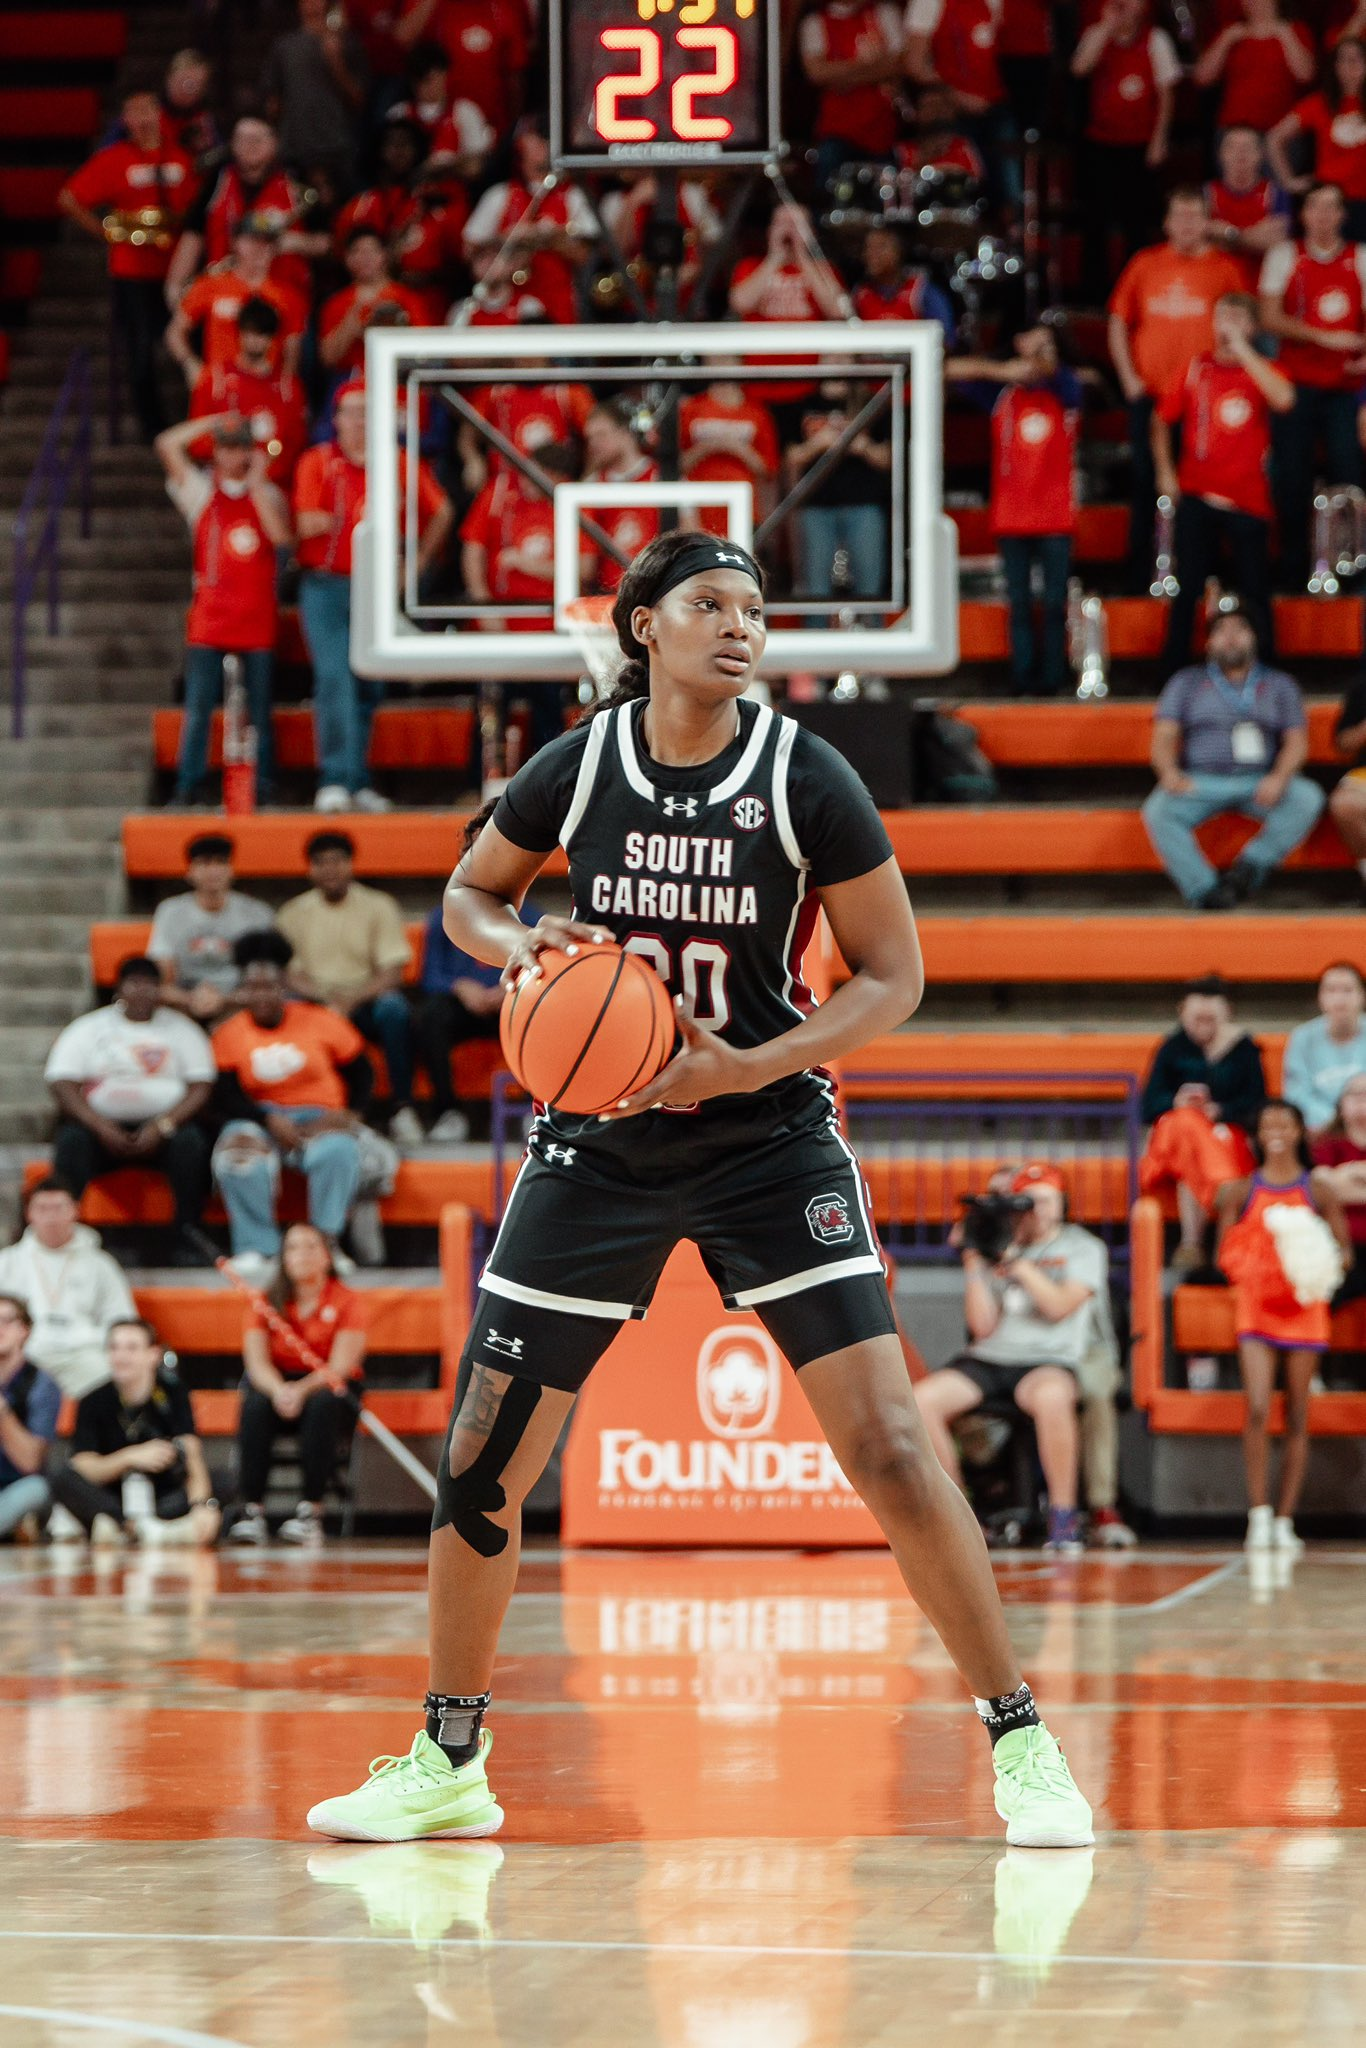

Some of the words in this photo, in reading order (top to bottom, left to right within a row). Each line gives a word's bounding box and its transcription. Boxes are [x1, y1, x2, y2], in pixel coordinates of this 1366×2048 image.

[596, 26, 738, 142] 22
[733, 797, 766, 829] SEC
[625, 831, 734, 877] SOUTH
[591, 874, 758, 925] CAROLINA
